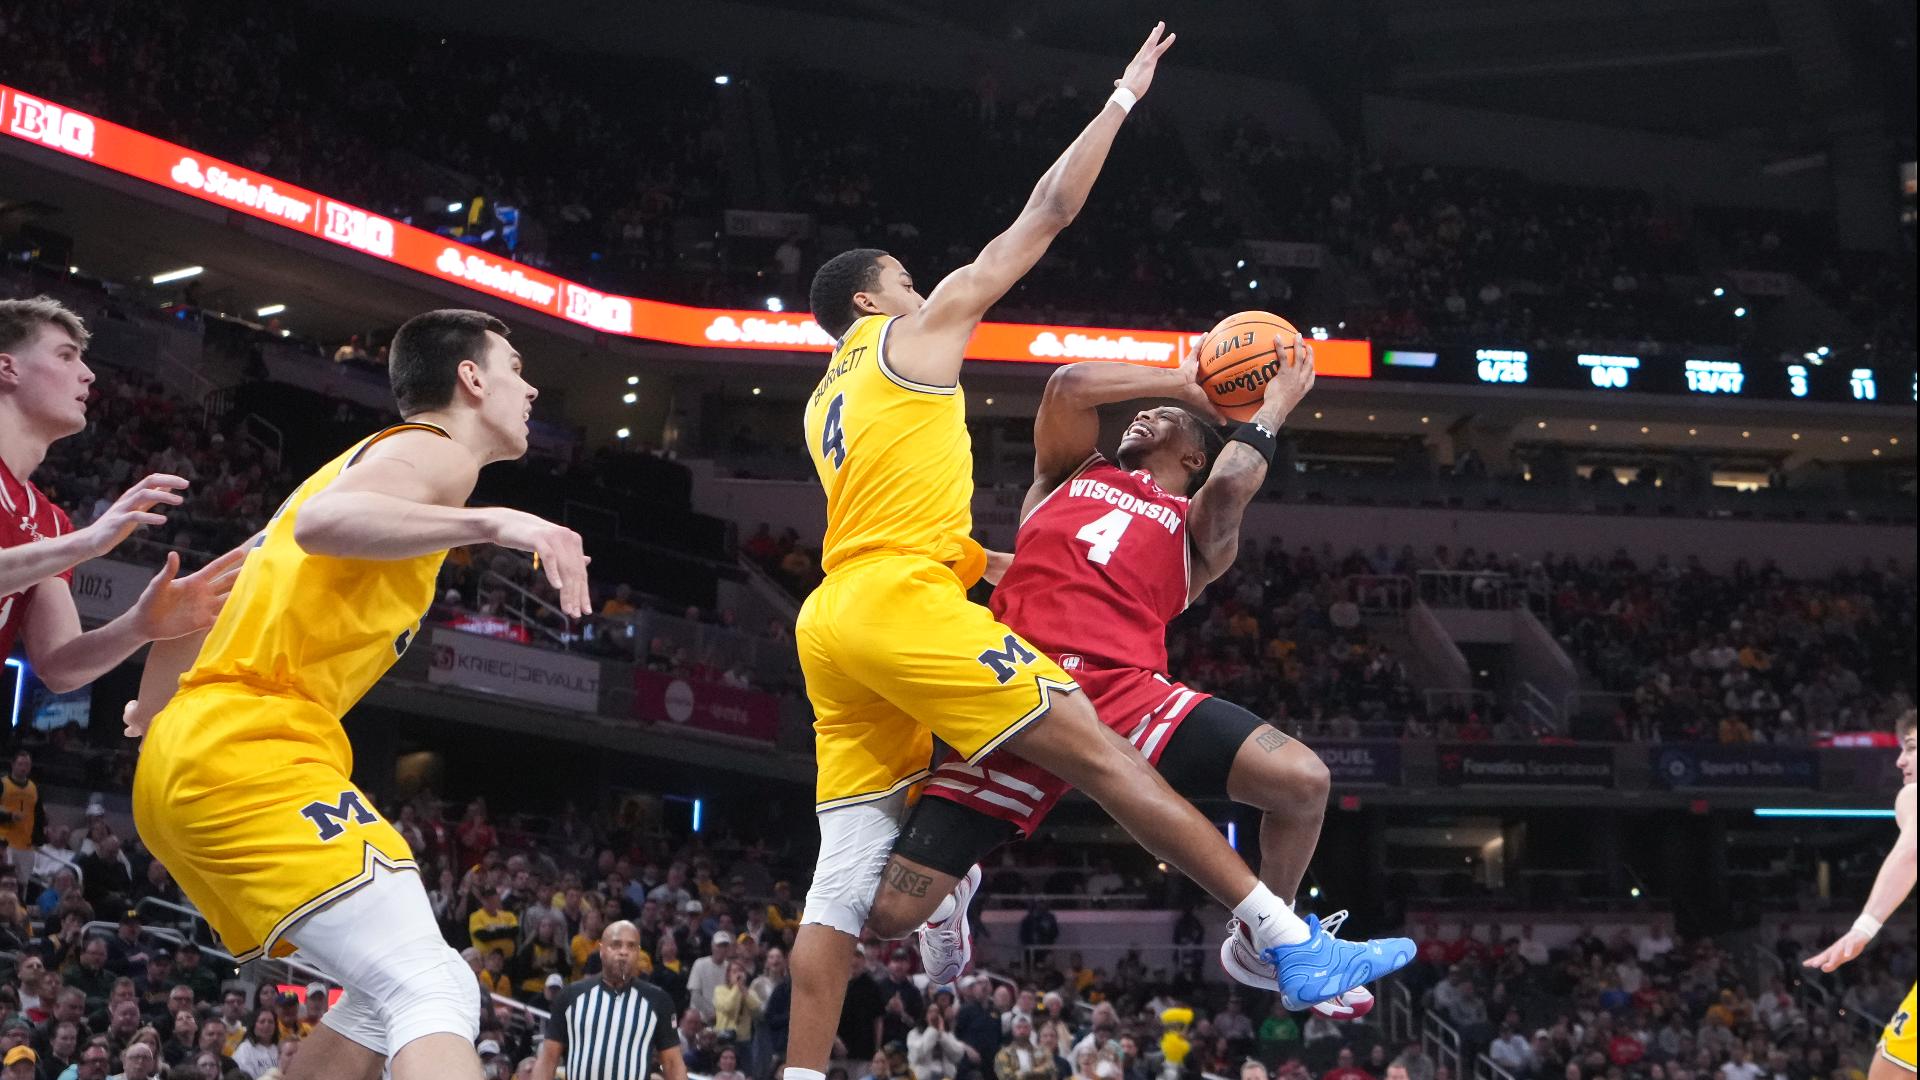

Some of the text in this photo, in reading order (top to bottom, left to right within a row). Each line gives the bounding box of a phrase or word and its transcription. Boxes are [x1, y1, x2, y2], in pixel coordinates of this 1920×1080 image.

[814, 346, 867, 407] BURNETT
[1477, 361, 1528, 382] 6/25
[1790, 375, 1808, 397] 3
[1849, 378, 1877, 400] 11
[823, 393, 846, 471] 4
[1069, 479, 1182, 534] WISCONSIN
[1075, 508, 1133, 565] 4
[977, 633, 1038, 685] M
[299, 790, 379, 842] M
[886, 860, 933, 898] RISE
